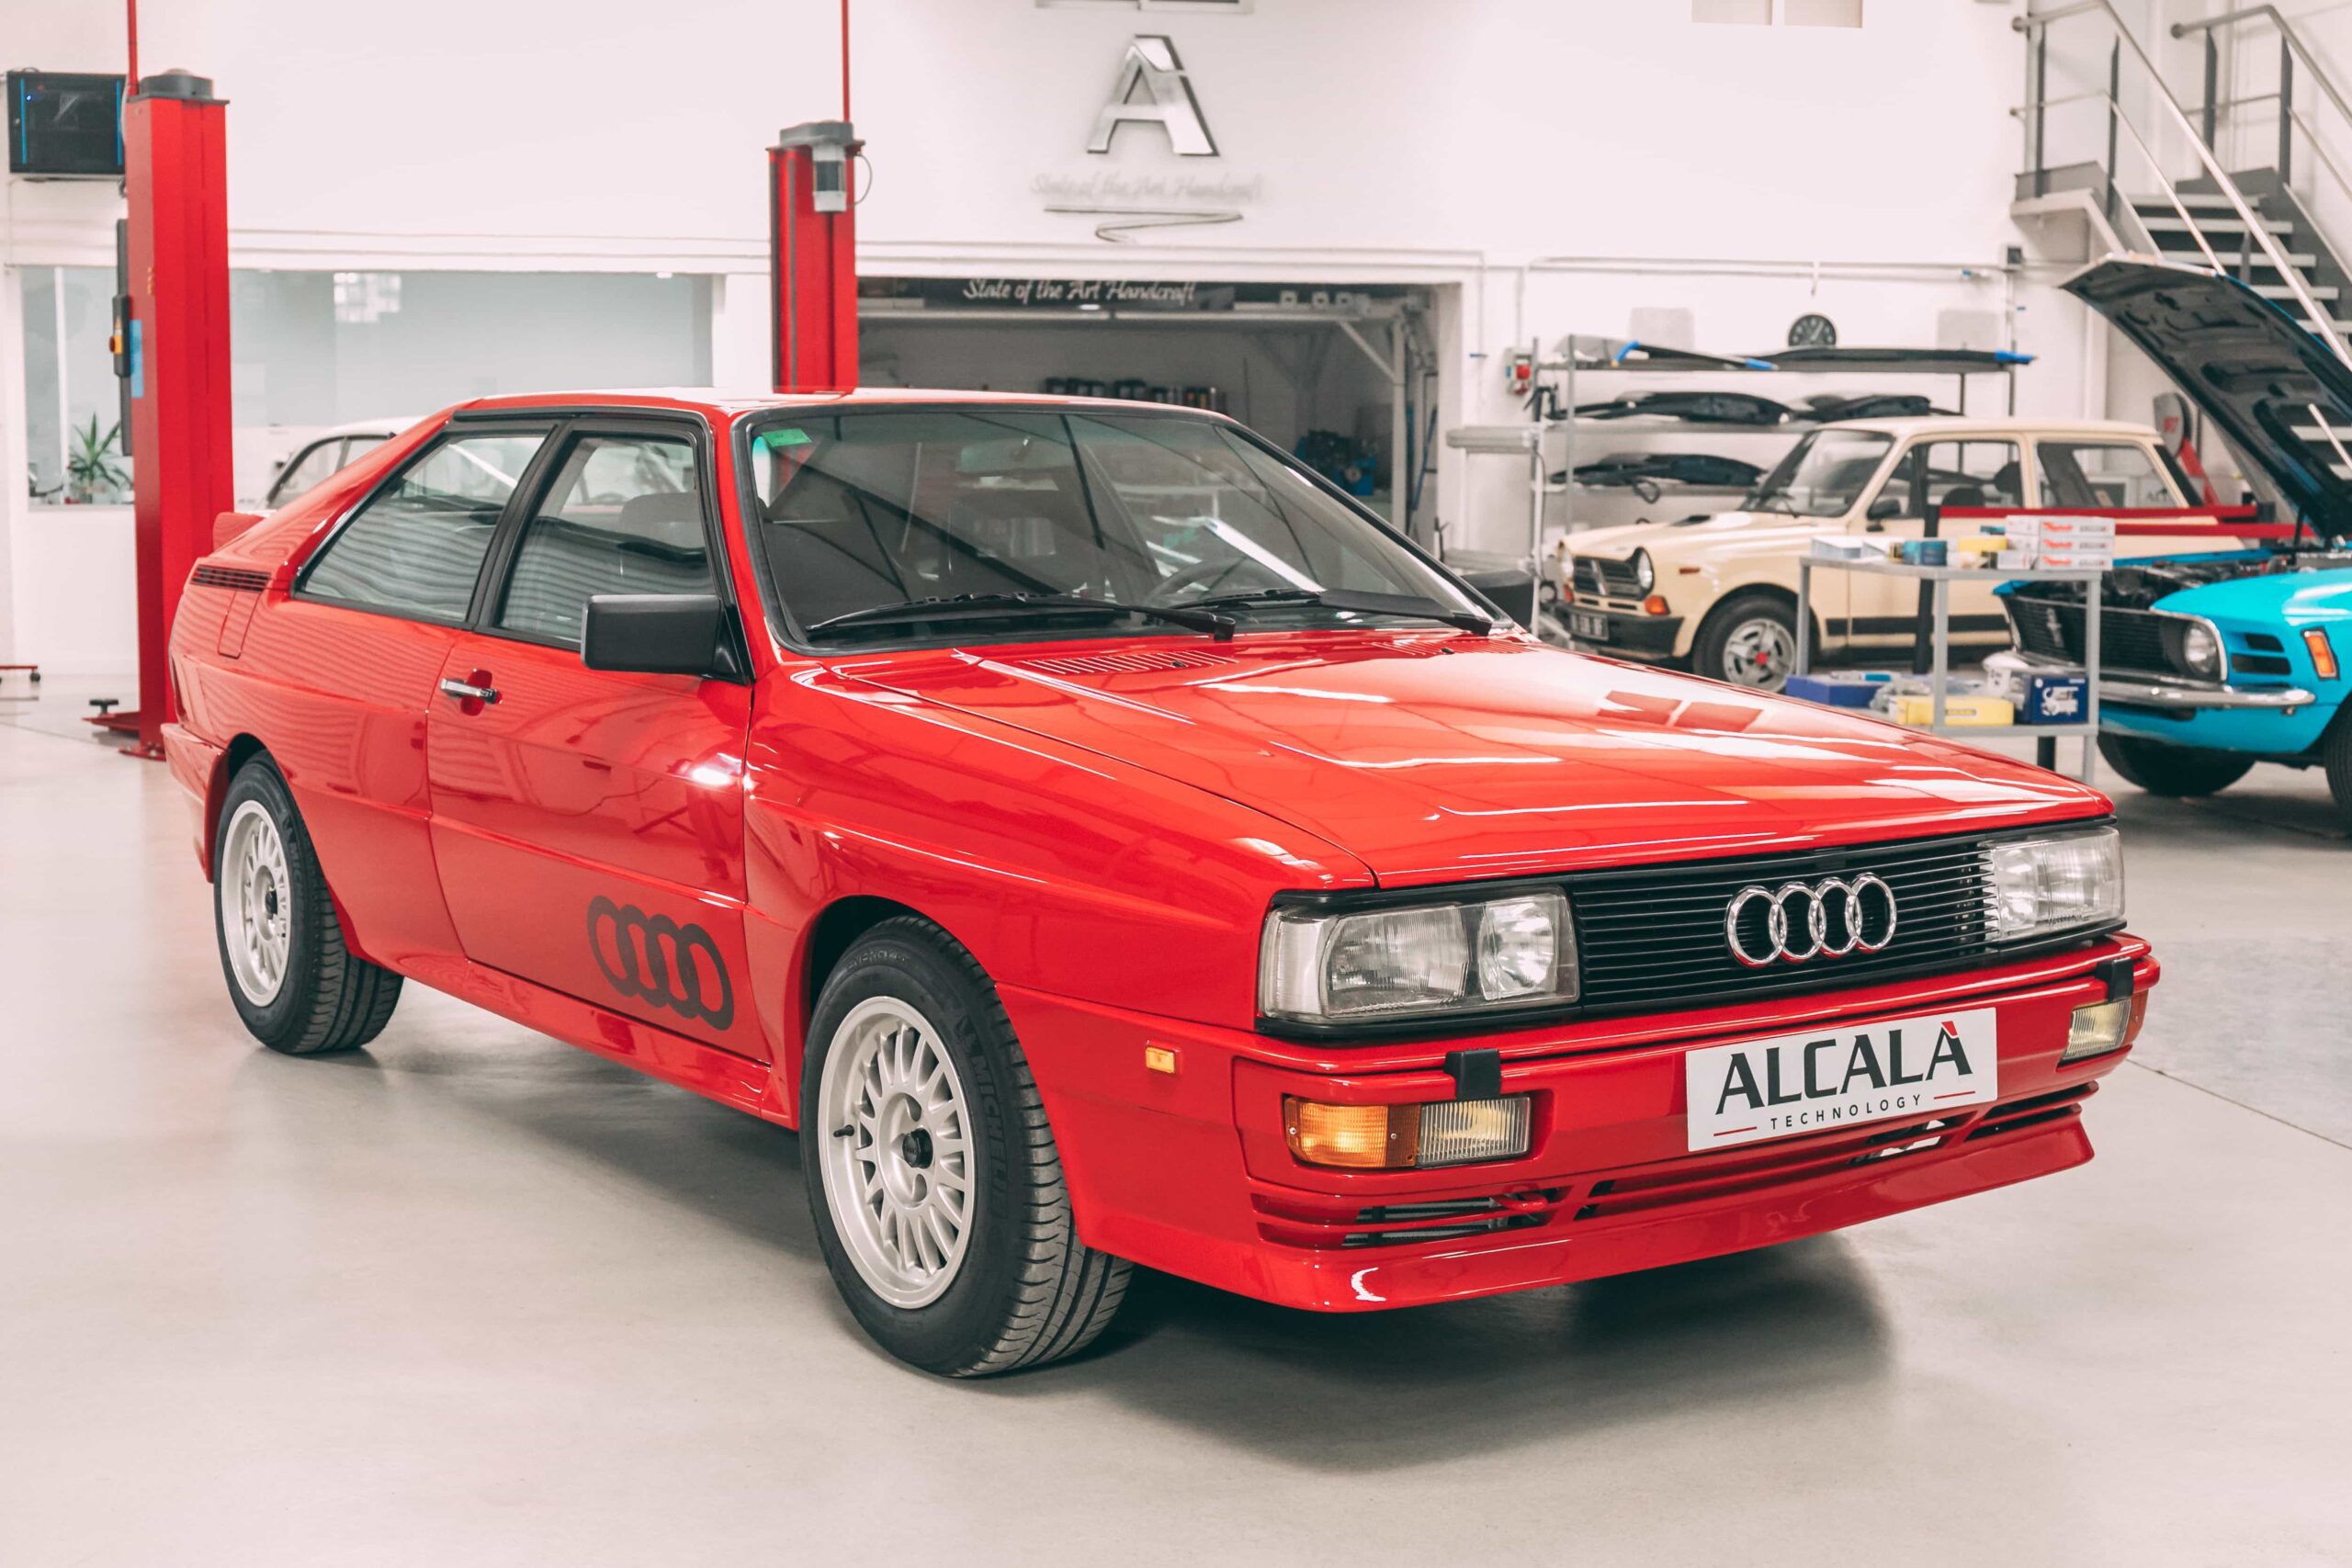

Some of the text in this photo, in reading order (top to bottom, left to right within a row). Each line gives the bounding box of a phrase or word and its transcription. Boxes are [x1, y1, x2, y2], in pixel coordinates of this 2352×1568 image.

[963, 279, 1194, 307] State of the Art Handcraft
[1770, 1094, 1922, 1130] TECHNOLOGY
